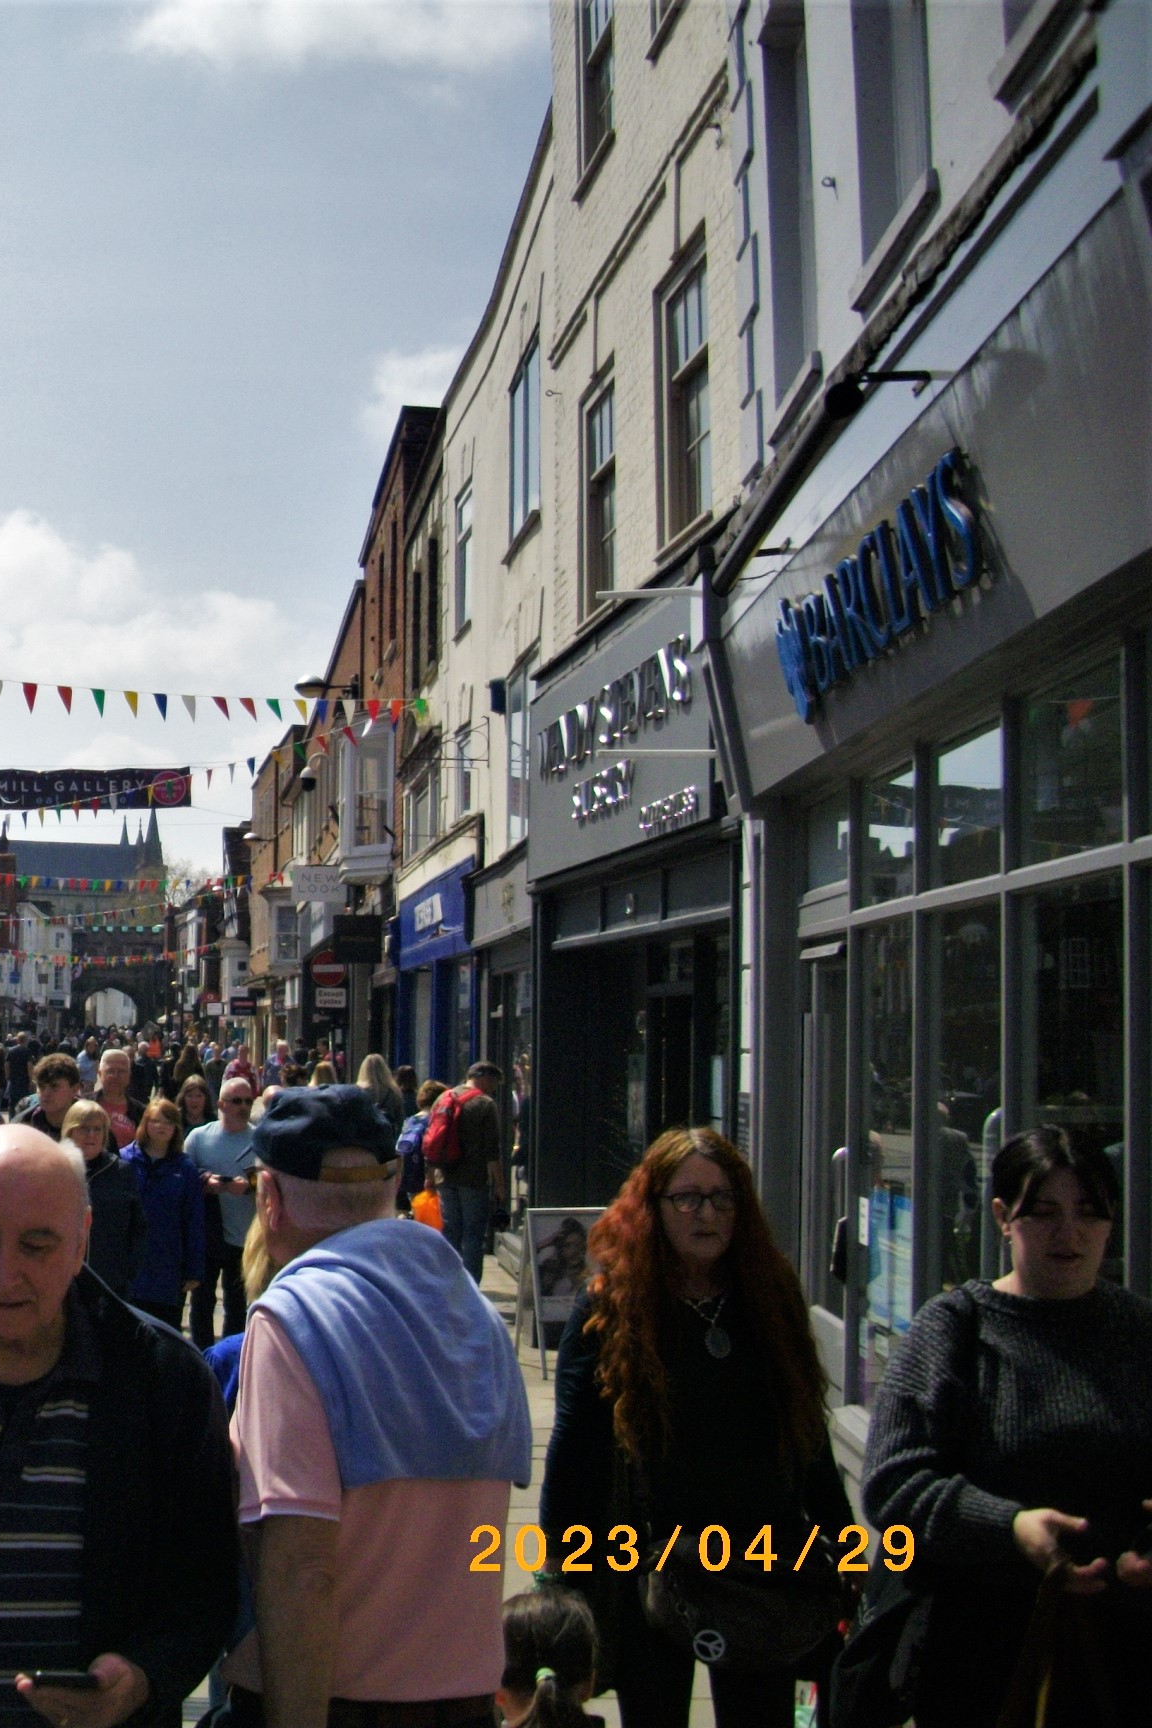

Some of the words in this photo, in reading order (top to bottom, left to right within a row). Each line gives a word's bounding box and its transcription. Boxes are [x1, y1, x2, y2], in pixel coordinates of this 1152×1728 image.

[802, 446, 977, 693] BARCLAYS
[54, 780, 145, 792] GALLERY
[301, 873, 340, 883] NEW
[298, 884, 341, 894] LOOK
